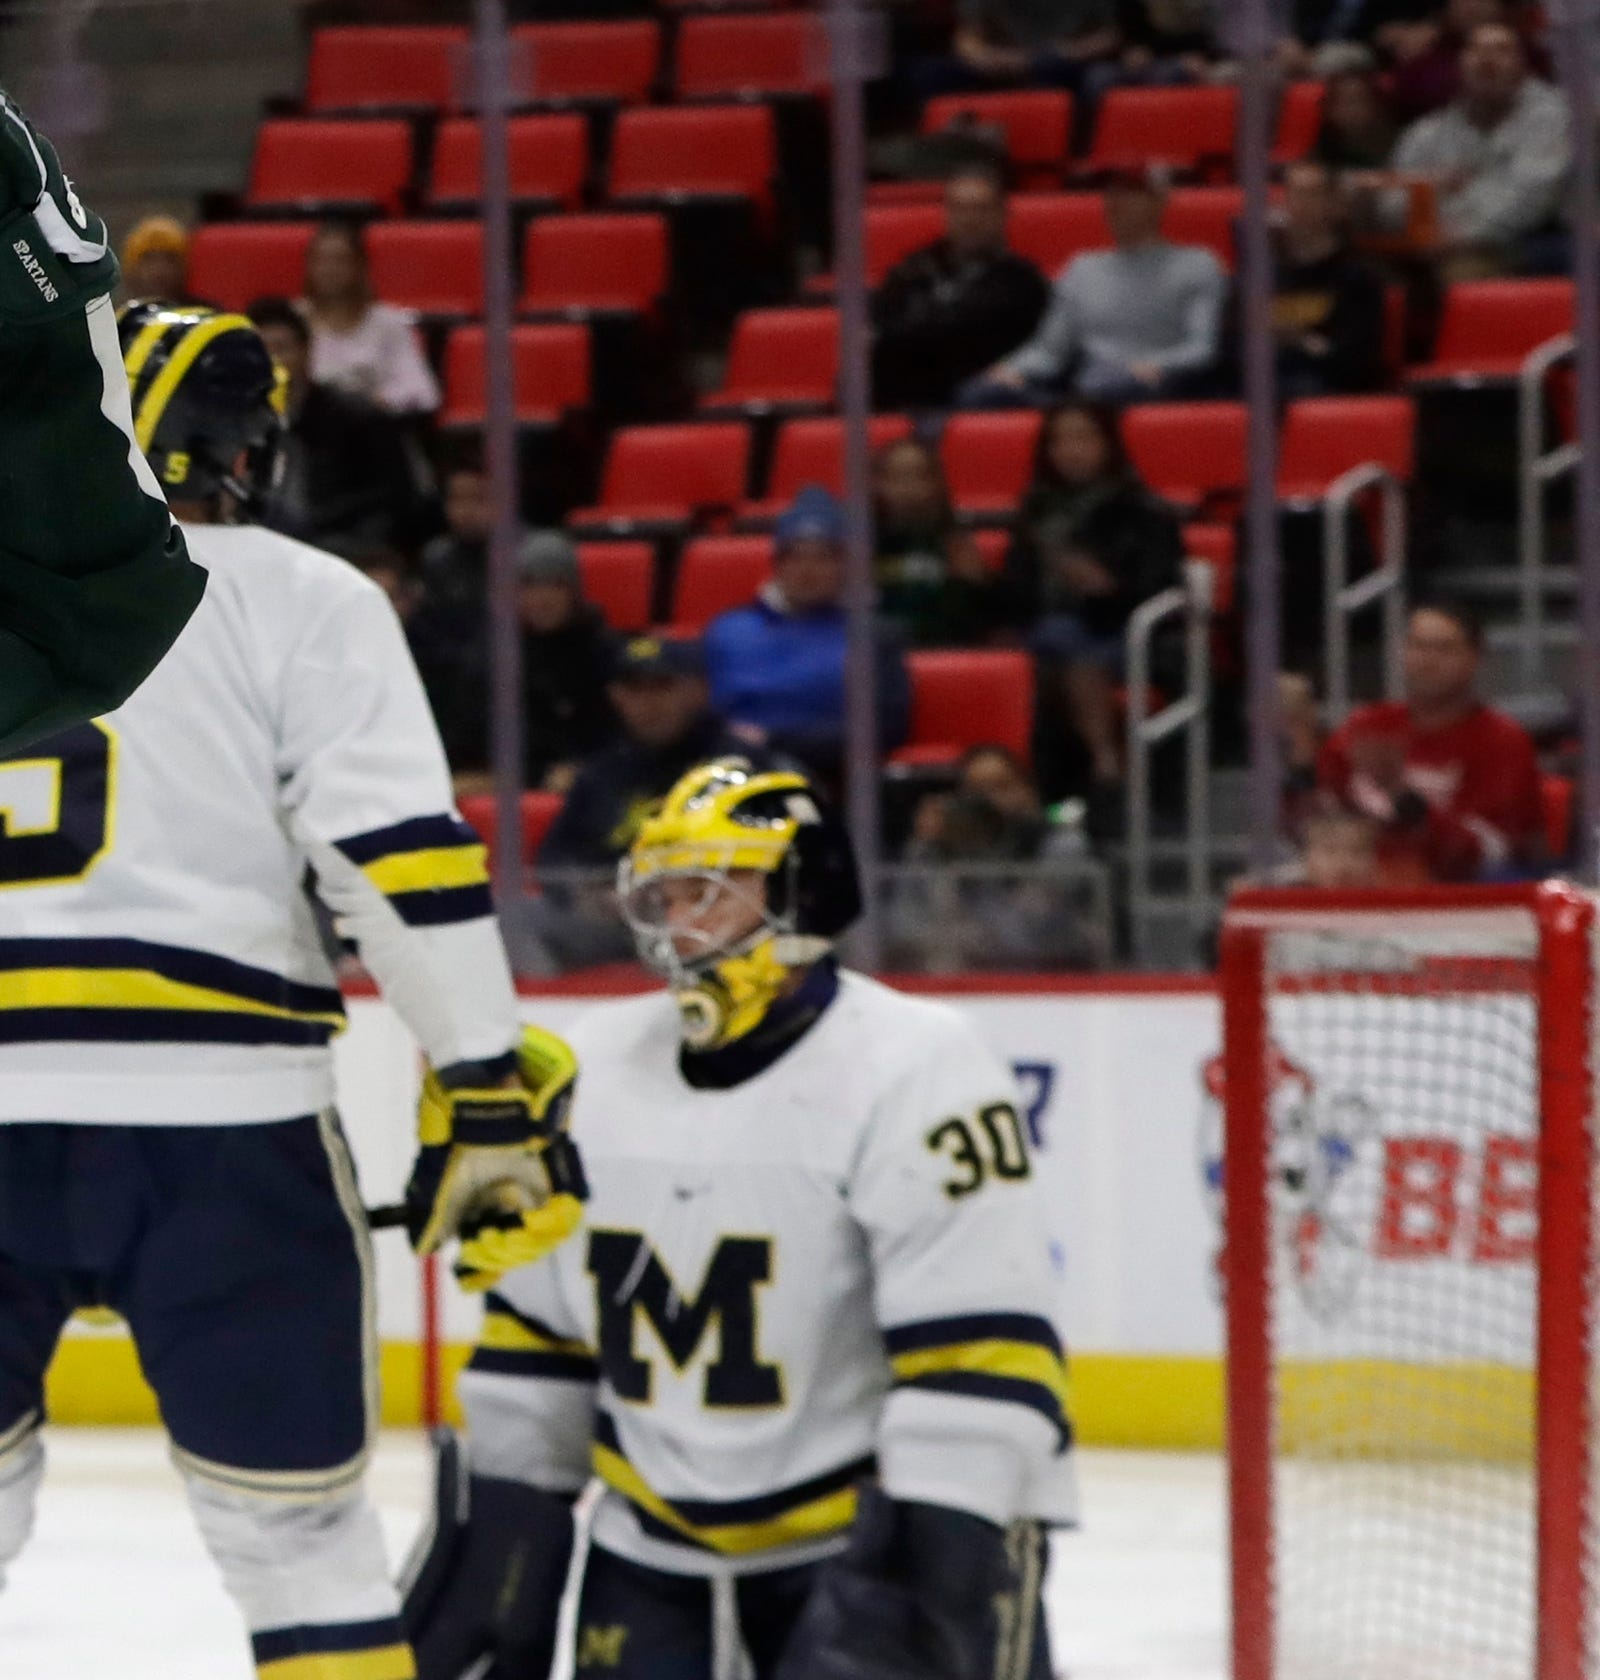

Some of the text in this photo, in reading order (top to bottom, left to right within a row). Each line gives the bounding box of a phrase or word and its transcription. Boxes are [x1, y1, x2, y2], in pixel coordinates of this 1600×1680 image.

[12, 238, 59, 303] SPARTANS
[924, 1097, 1032, 1202] 30
[584, 1225, 788, 1412] M
